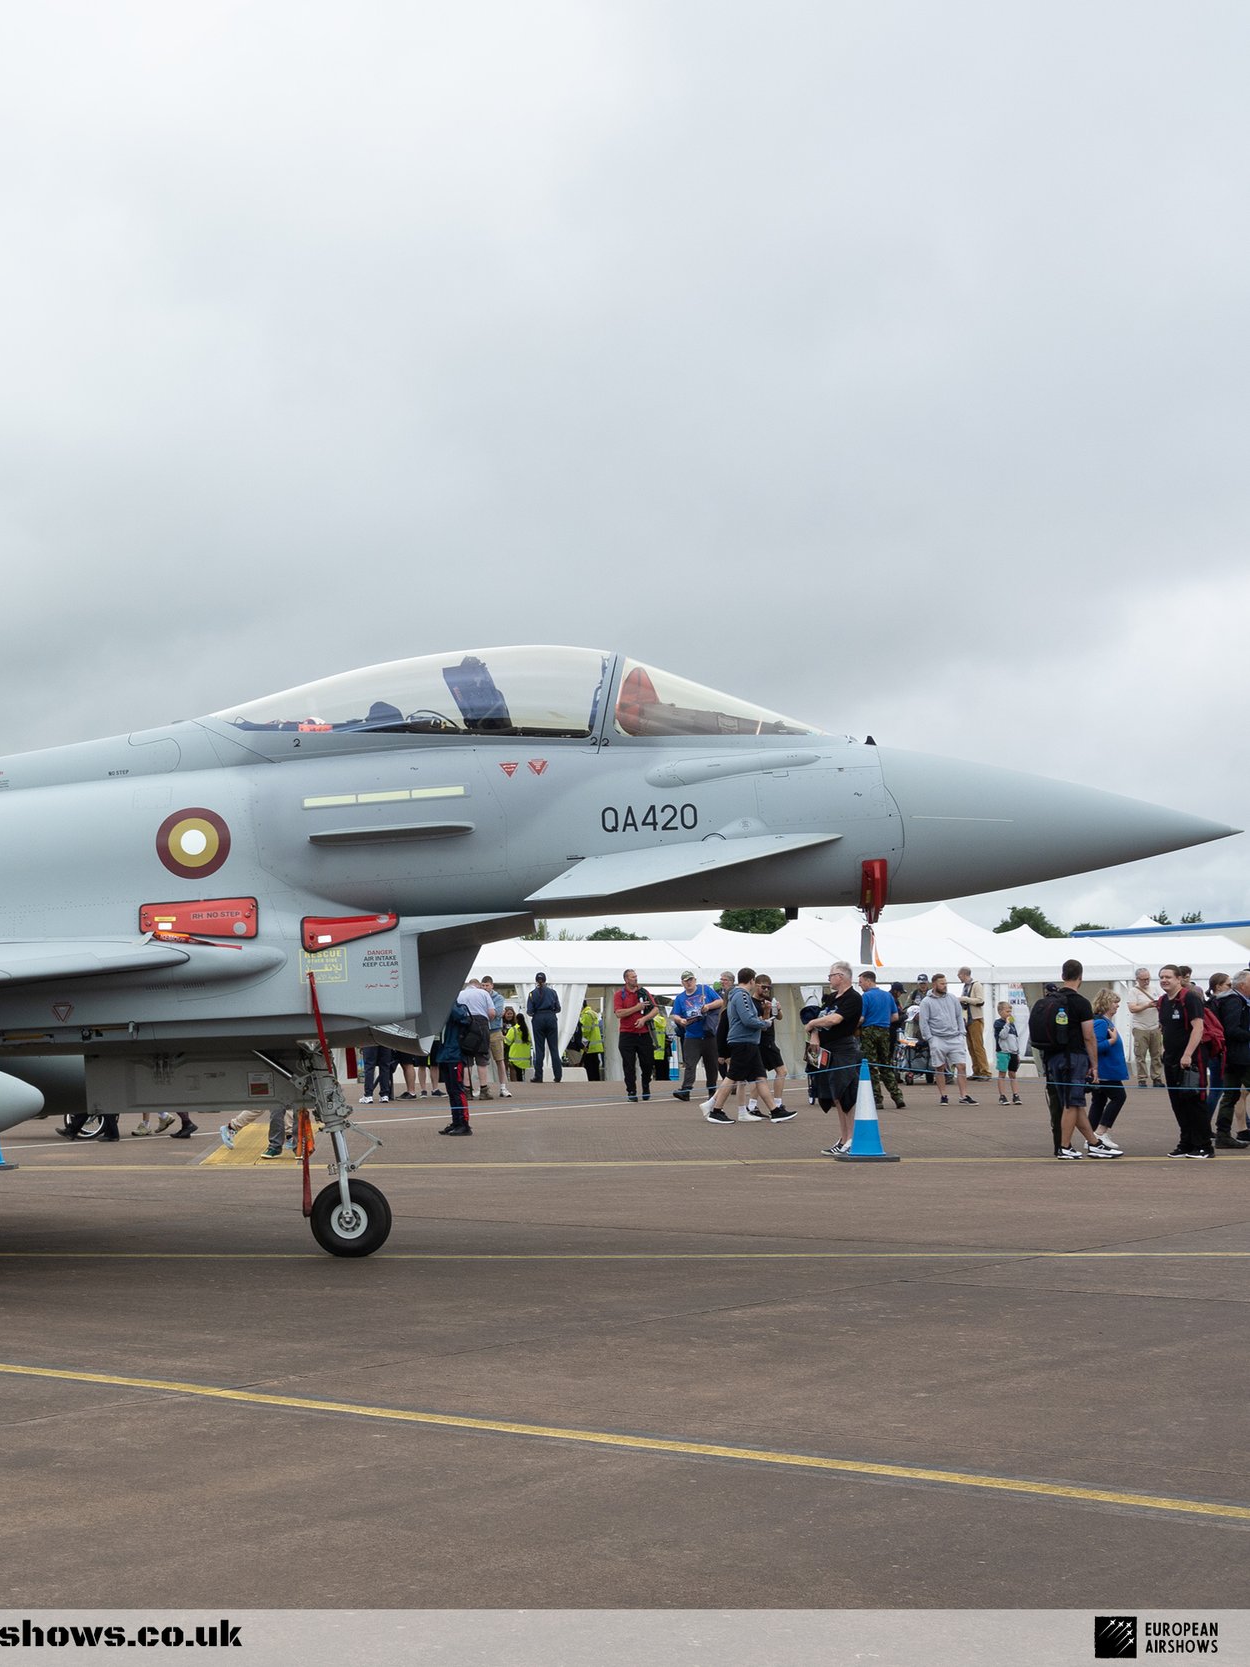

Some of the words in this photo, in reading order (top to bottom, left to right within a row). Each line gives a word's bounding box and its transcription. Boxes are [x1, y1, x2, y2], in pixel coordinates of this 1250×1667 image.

[293, 738, 301, 748] 2
[590, 736, 598, 746] 2
[601, 737, 610, 747] 2
[601, 803, 698, 833] QA420
[220, 910, 241, 918] STEP
